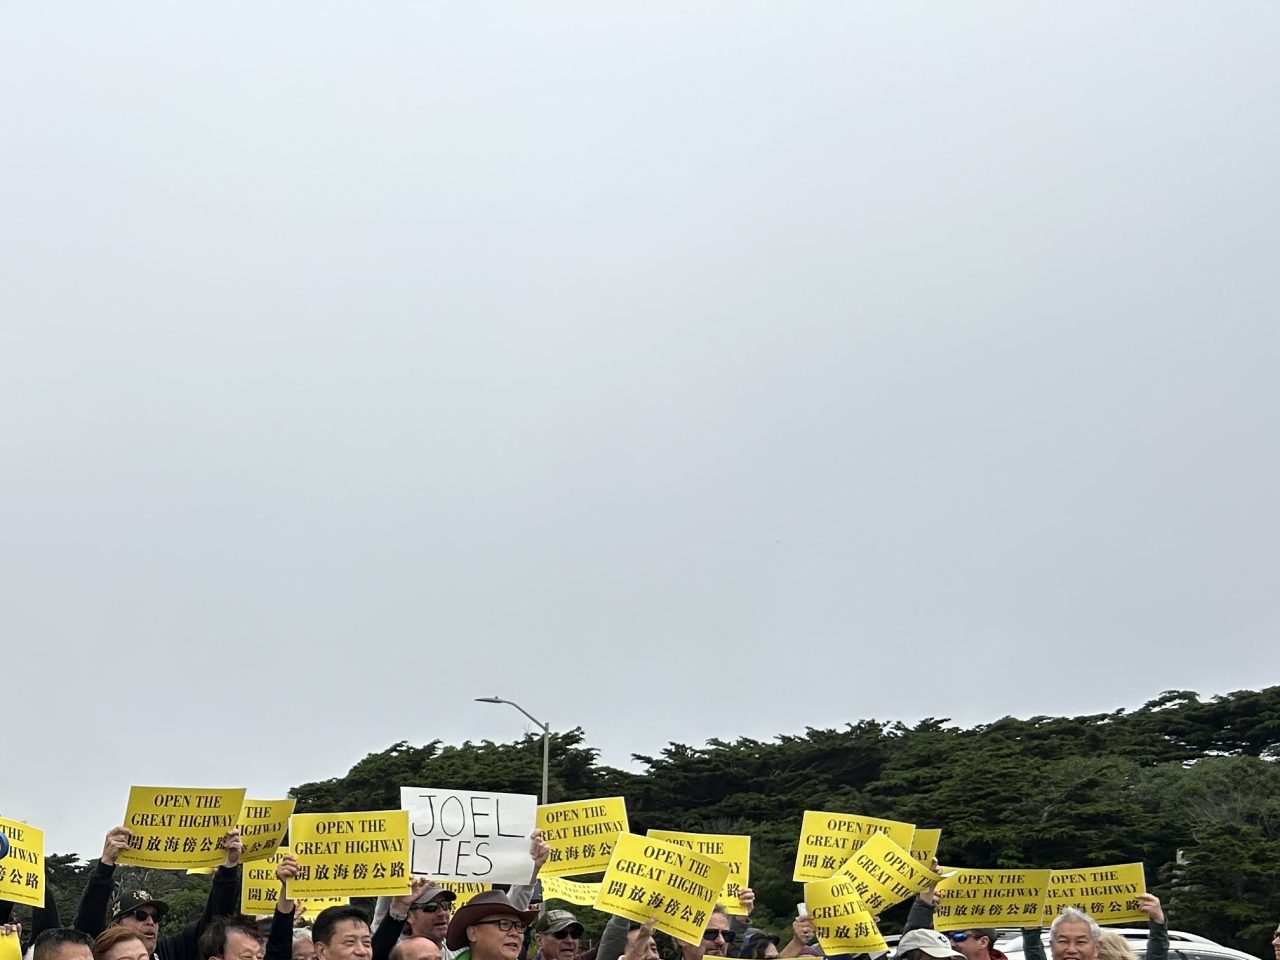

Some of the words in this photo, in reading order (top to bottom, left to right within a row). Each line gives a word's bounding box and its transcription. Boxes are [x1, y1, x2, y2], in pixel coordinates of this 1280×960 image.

[153, 793, 193, 808] OPEN
[131, 813, 176, 827] GREAT
[177, 814, 236, 828] HIGHWAY
[411, 795, 525, 838] JOEL
[546, 808, 579, 824] OPEN
[582, 804, 607, 819] THE
[315, 820, 354, 835] OPEN
[359, 819, 387, 833] THE
[572, 820, 624, 838] HIGHWAY
[827, 818, 863, 834] OPEN
[294, 840, 338, 855] GREAT
[345, 838, 404, 854] HIGHWAY
[806, 834, 849, 850] GREAT
[410, 838, 494, 877] LIES
[883, 850, 919, 881] OPEN
[856, 854, 894, 886] GREAT
[957, 874, 997, 885] OPEN
[999, 874, 1026, 884] THE
[938, 888, 980, 899] GREAT
[983, 887, 1041, 898] HIGHWAY
[937, 903, 1038, 917] 開放海傍公路
